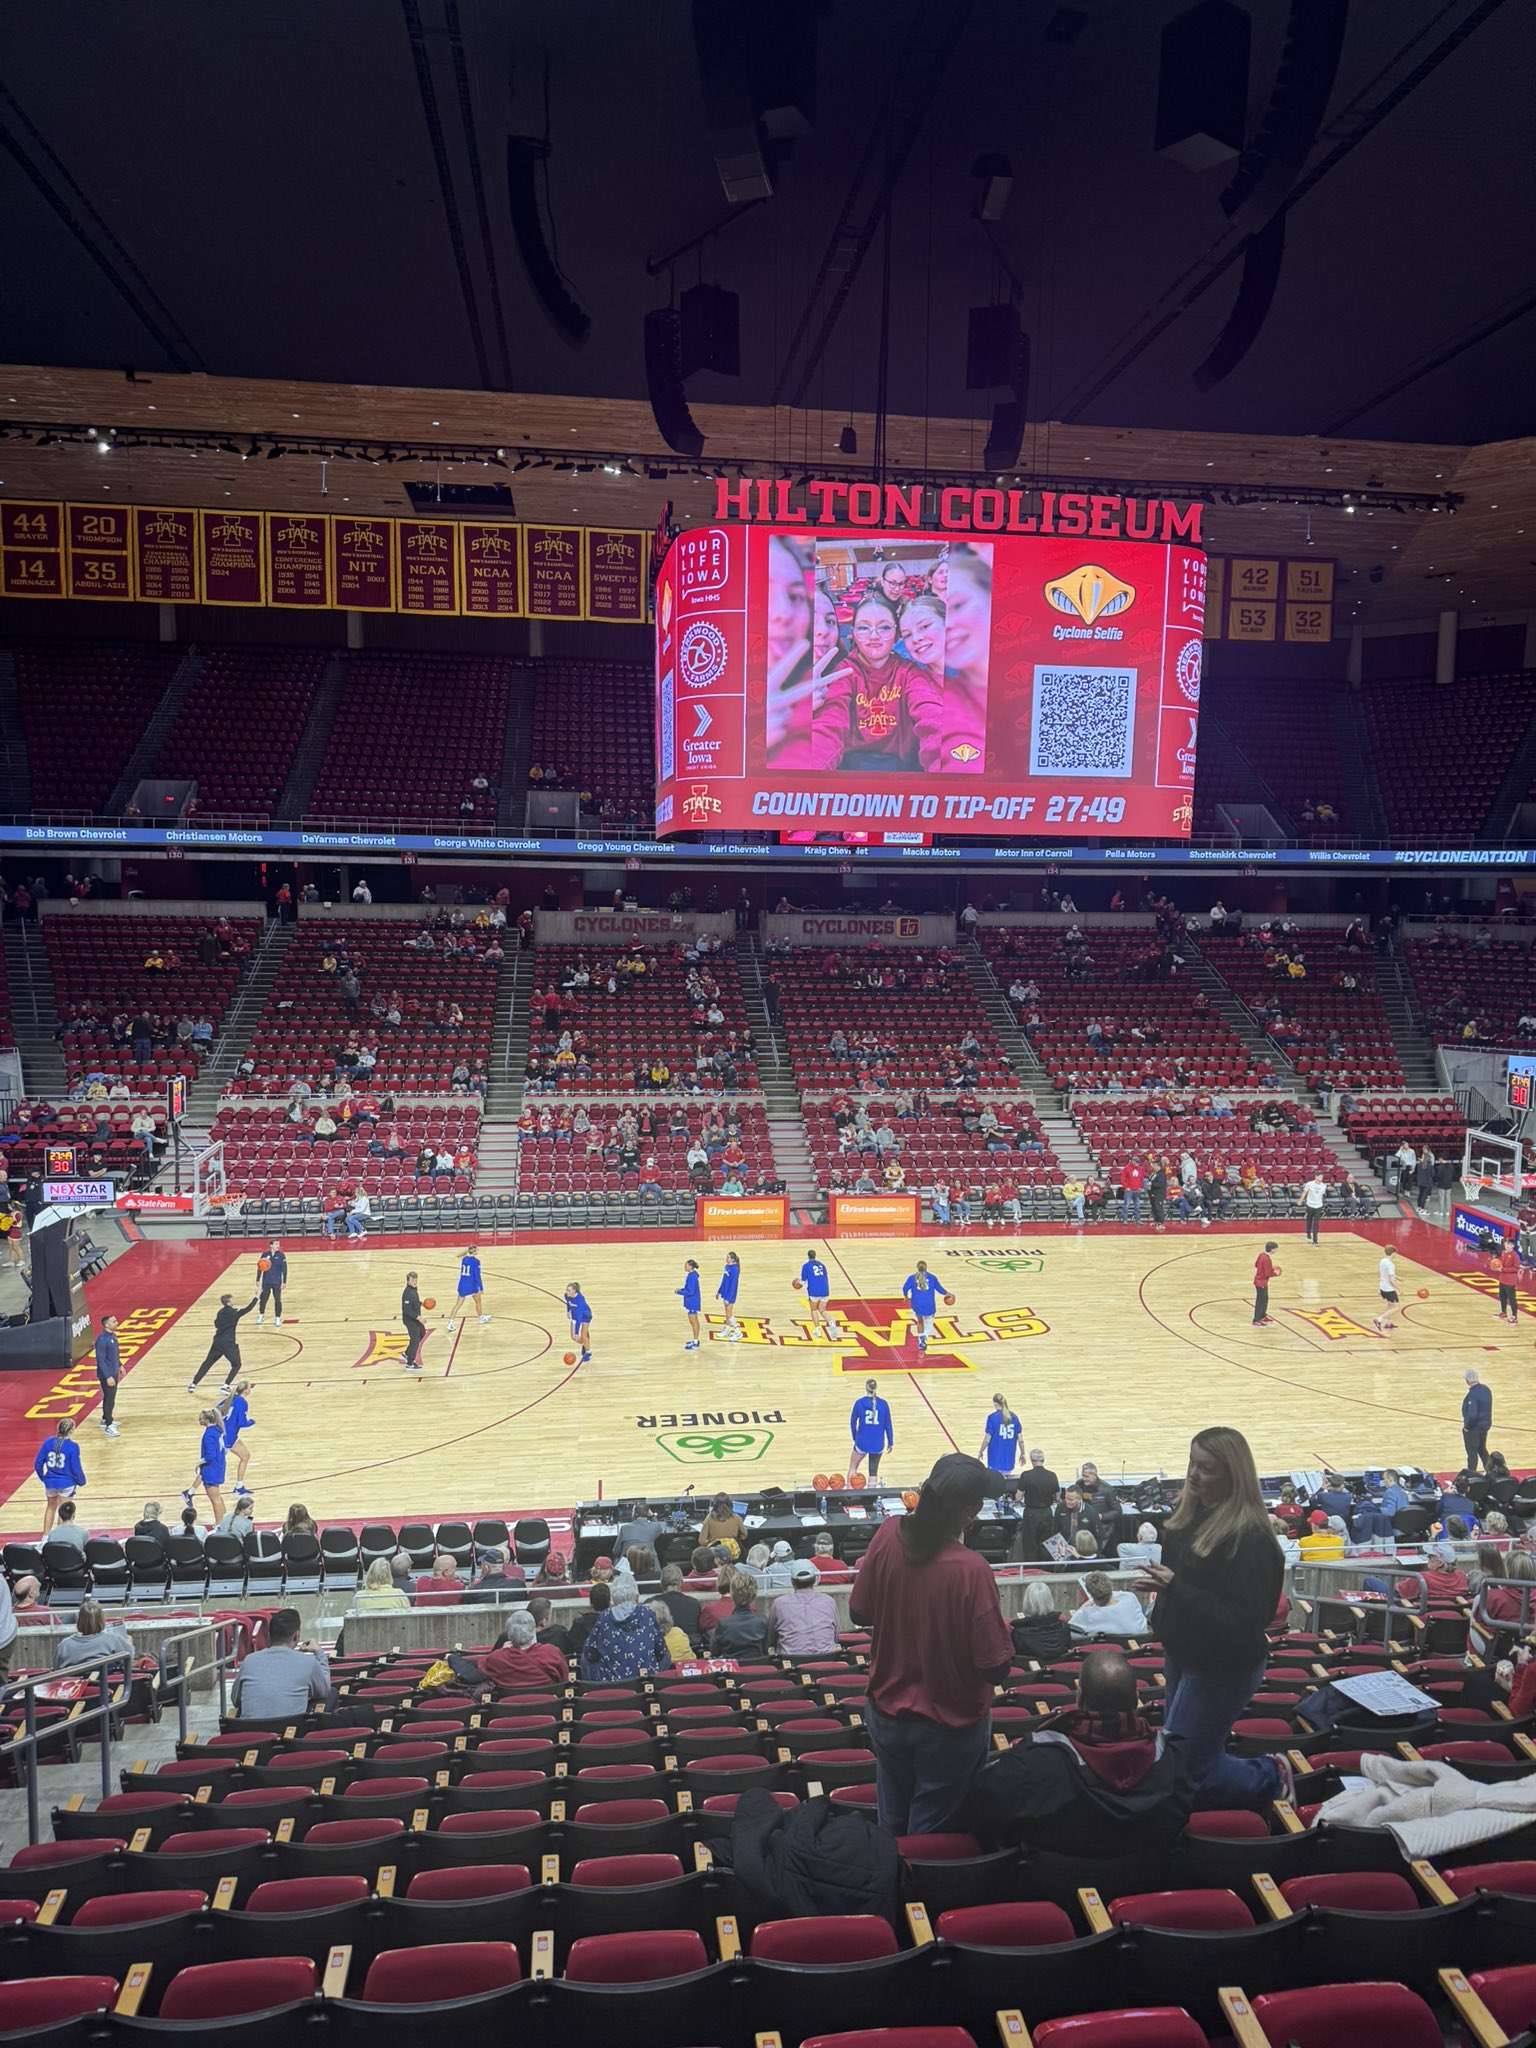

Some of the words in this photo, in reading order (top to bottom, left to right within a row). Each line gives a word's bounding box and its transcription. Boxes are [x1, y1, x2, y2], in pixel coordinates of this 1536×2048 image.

[715, 477, 924, 527] HILTON
[940, 487, 1204, 543] COLISEUM
[13, 513, 47, 532] 44
[82, 515, 116, 535] 20
[145, 521, 187, 537] STATE
[76, 534, 123, 543] THOMPSON
[211, 525, 253, 540] STATE
[277, 527, 319, 544] STATE
[343, 531, 384, 546] STATE
[407, 534, 448, 550] STATE
[471, 537, 512, 552] STATE
[534, 540, 574, 555] STATE
[681, 538, 721, 556] YOUR
[596, 543, 635, 559] STATE
[20, 559, 45, 578] 14
[143, 559, 190, 567] CHAMPIONS
[210, 560, 256, 569] CHAMPIONS
[274, 563, 323, 571] CHAMPIONS
[349, 560, 377, 573] NIT
[681, 553, 720, 571] LIFE
[84, 561, 116, 581] 35
[409, 565, 446, 576] NCAA
[473, 567, 510, 578] NCAA
[536, 570, 572, 581] NCAA
[681, 569, 721, 585] IOWA
[1241, 568, 1269, 585] 42
[10, 578, 56, 586] HORNACEK
[593, 574, 626, 583] SWEET
[1300, 569, 1320, 587] 51
[704, 594, 721, 602] HHS
[1240, 609, 1266, 626] 53
[1295, 611, 1322, 628] 32
[1052, 625, 1093, 641] Cyclone
[1094, 627, 1124, 641] Selfie
[682, 627, 720, 662] BERKWOOD
[690, 665, 719, 683] FARMS
[683, 739, 722, 752] Greater
[688, 752, 712, 764] Iowa
[682, 796, 722, 814] STATE
[752, 791, 904, 818] COUNTDOWN
[909, 794, 939, 818] TO
[944, 795, 1036, 820] TIP-OFF
[1044, 795, 1126, 823] 27:49
[26, 828, 45, 838] Bob
[47, 829, 78, 839] Brown
[80, 829, 127, 839] Chevrolet
[166, 831, 227, 842] Christiansen
[229, 833, 263, 842] Motors
[302, 834, 349, 844] DeYarman
[351, 835, 396, 846] Chevrolet
[434, 838, 467, 849] George
[468, 839, 496, 848] White
[497, 839, 541, 849] Chevrolet
[577, 841, 604, 852] Gregg
[605, 842, 632, 852] Young
[633, 843, 675, 853] Chevrolet
[709, 844, 728, 853] Karl
[729, 845, 770, 854] Chevrolet
[168, 851, 183, 859] 130
[805, 846, 827, 856] Kraig
[903, 847, 930, 856] Macke
[931, 848, 961, 856] Motors
[994, 849, 1020, 857] Motor
[1020, 849, 1035, 857] Inn
[1035, 849, 1045, 857] of
[1045, 849, 1073, 857] Carroll
[1105, 850, 1126, 858] Pella
[1127, 850, 1156, 858] Motors
[1189, 850, 1237, 859] Shottenkirk
[1238, 851, 1277, 859] Chevrolet
[1309, 851, 1331, 860] Willis
[1332, 852, 1370, 860] Chevrolet
[1395, 850, 1528, 863] #CYCLONENATION
[627, 862, 640, 870] 132
[802, 919, 894, 935] CYCLONES
[1511, 1086, 1527, 1106] 30
[54, 1161, 70, 1172] 30
[50, 1183, 107, 1195] NEXSTAR
[717, 1207, 732, 1215] First
[732, 1207, 765, 1215] Interstate
[849, 1205, 863, 1213] First
[944, 1248, 1047, 1257] PIONEER
[461, 1264, 471, 1276] 11
[704, 1306, 1051, 1347] STATE
[636, 1410, 787, 1428] PIONEER
[865, 1410, 879, 1425] 21
[999, 1423, 1014, 1439] 45
[47, 1451, 66, 1468] 33
